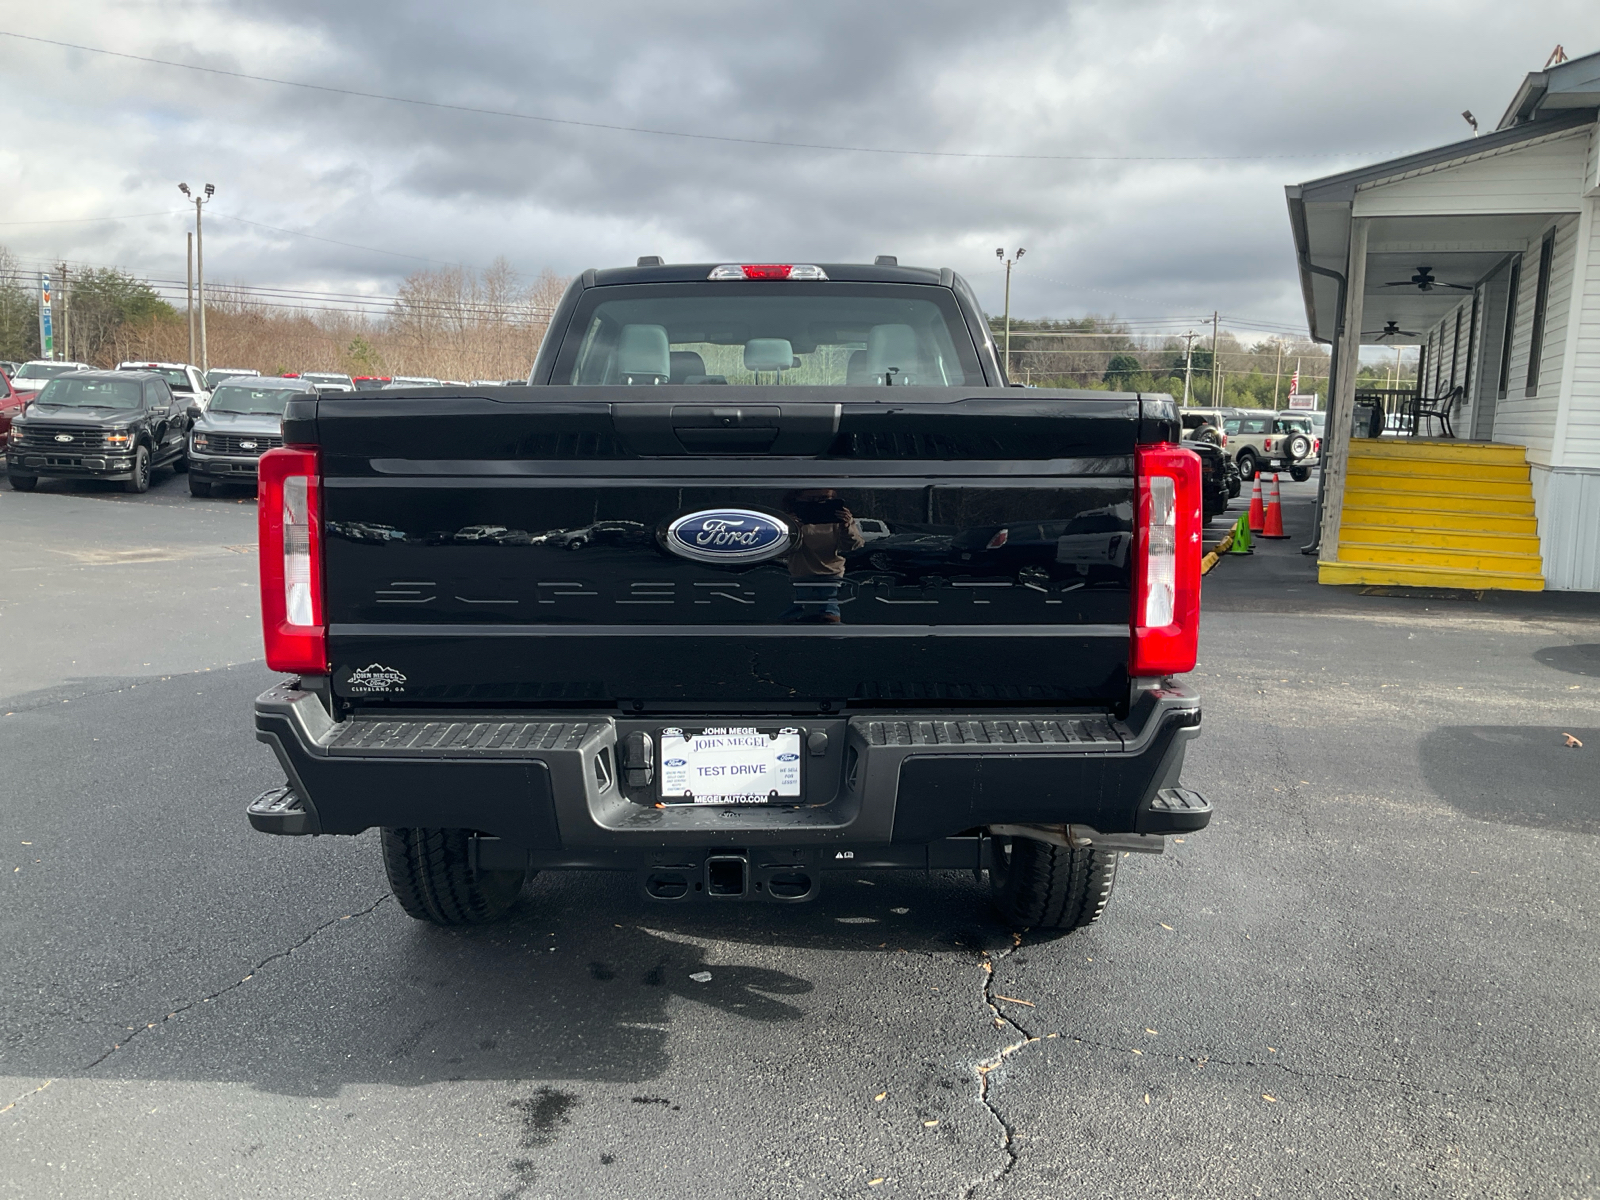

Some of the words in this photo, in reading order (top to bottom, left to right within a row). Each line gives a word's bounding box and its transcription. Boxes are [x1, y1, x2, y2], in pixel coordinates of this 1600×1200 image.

[696, 519, 760, 545] Ford
[374, 581, 756, 604] SUPER
[693, 738, 724, 752] JOHN
[727, 737, 768, 748] MEGEL
[697, 766, 727, 777] TEST
[730, 764, 767, 775] DRIVE
[694, 795, 768, 803] MEGELAUTO.COM
